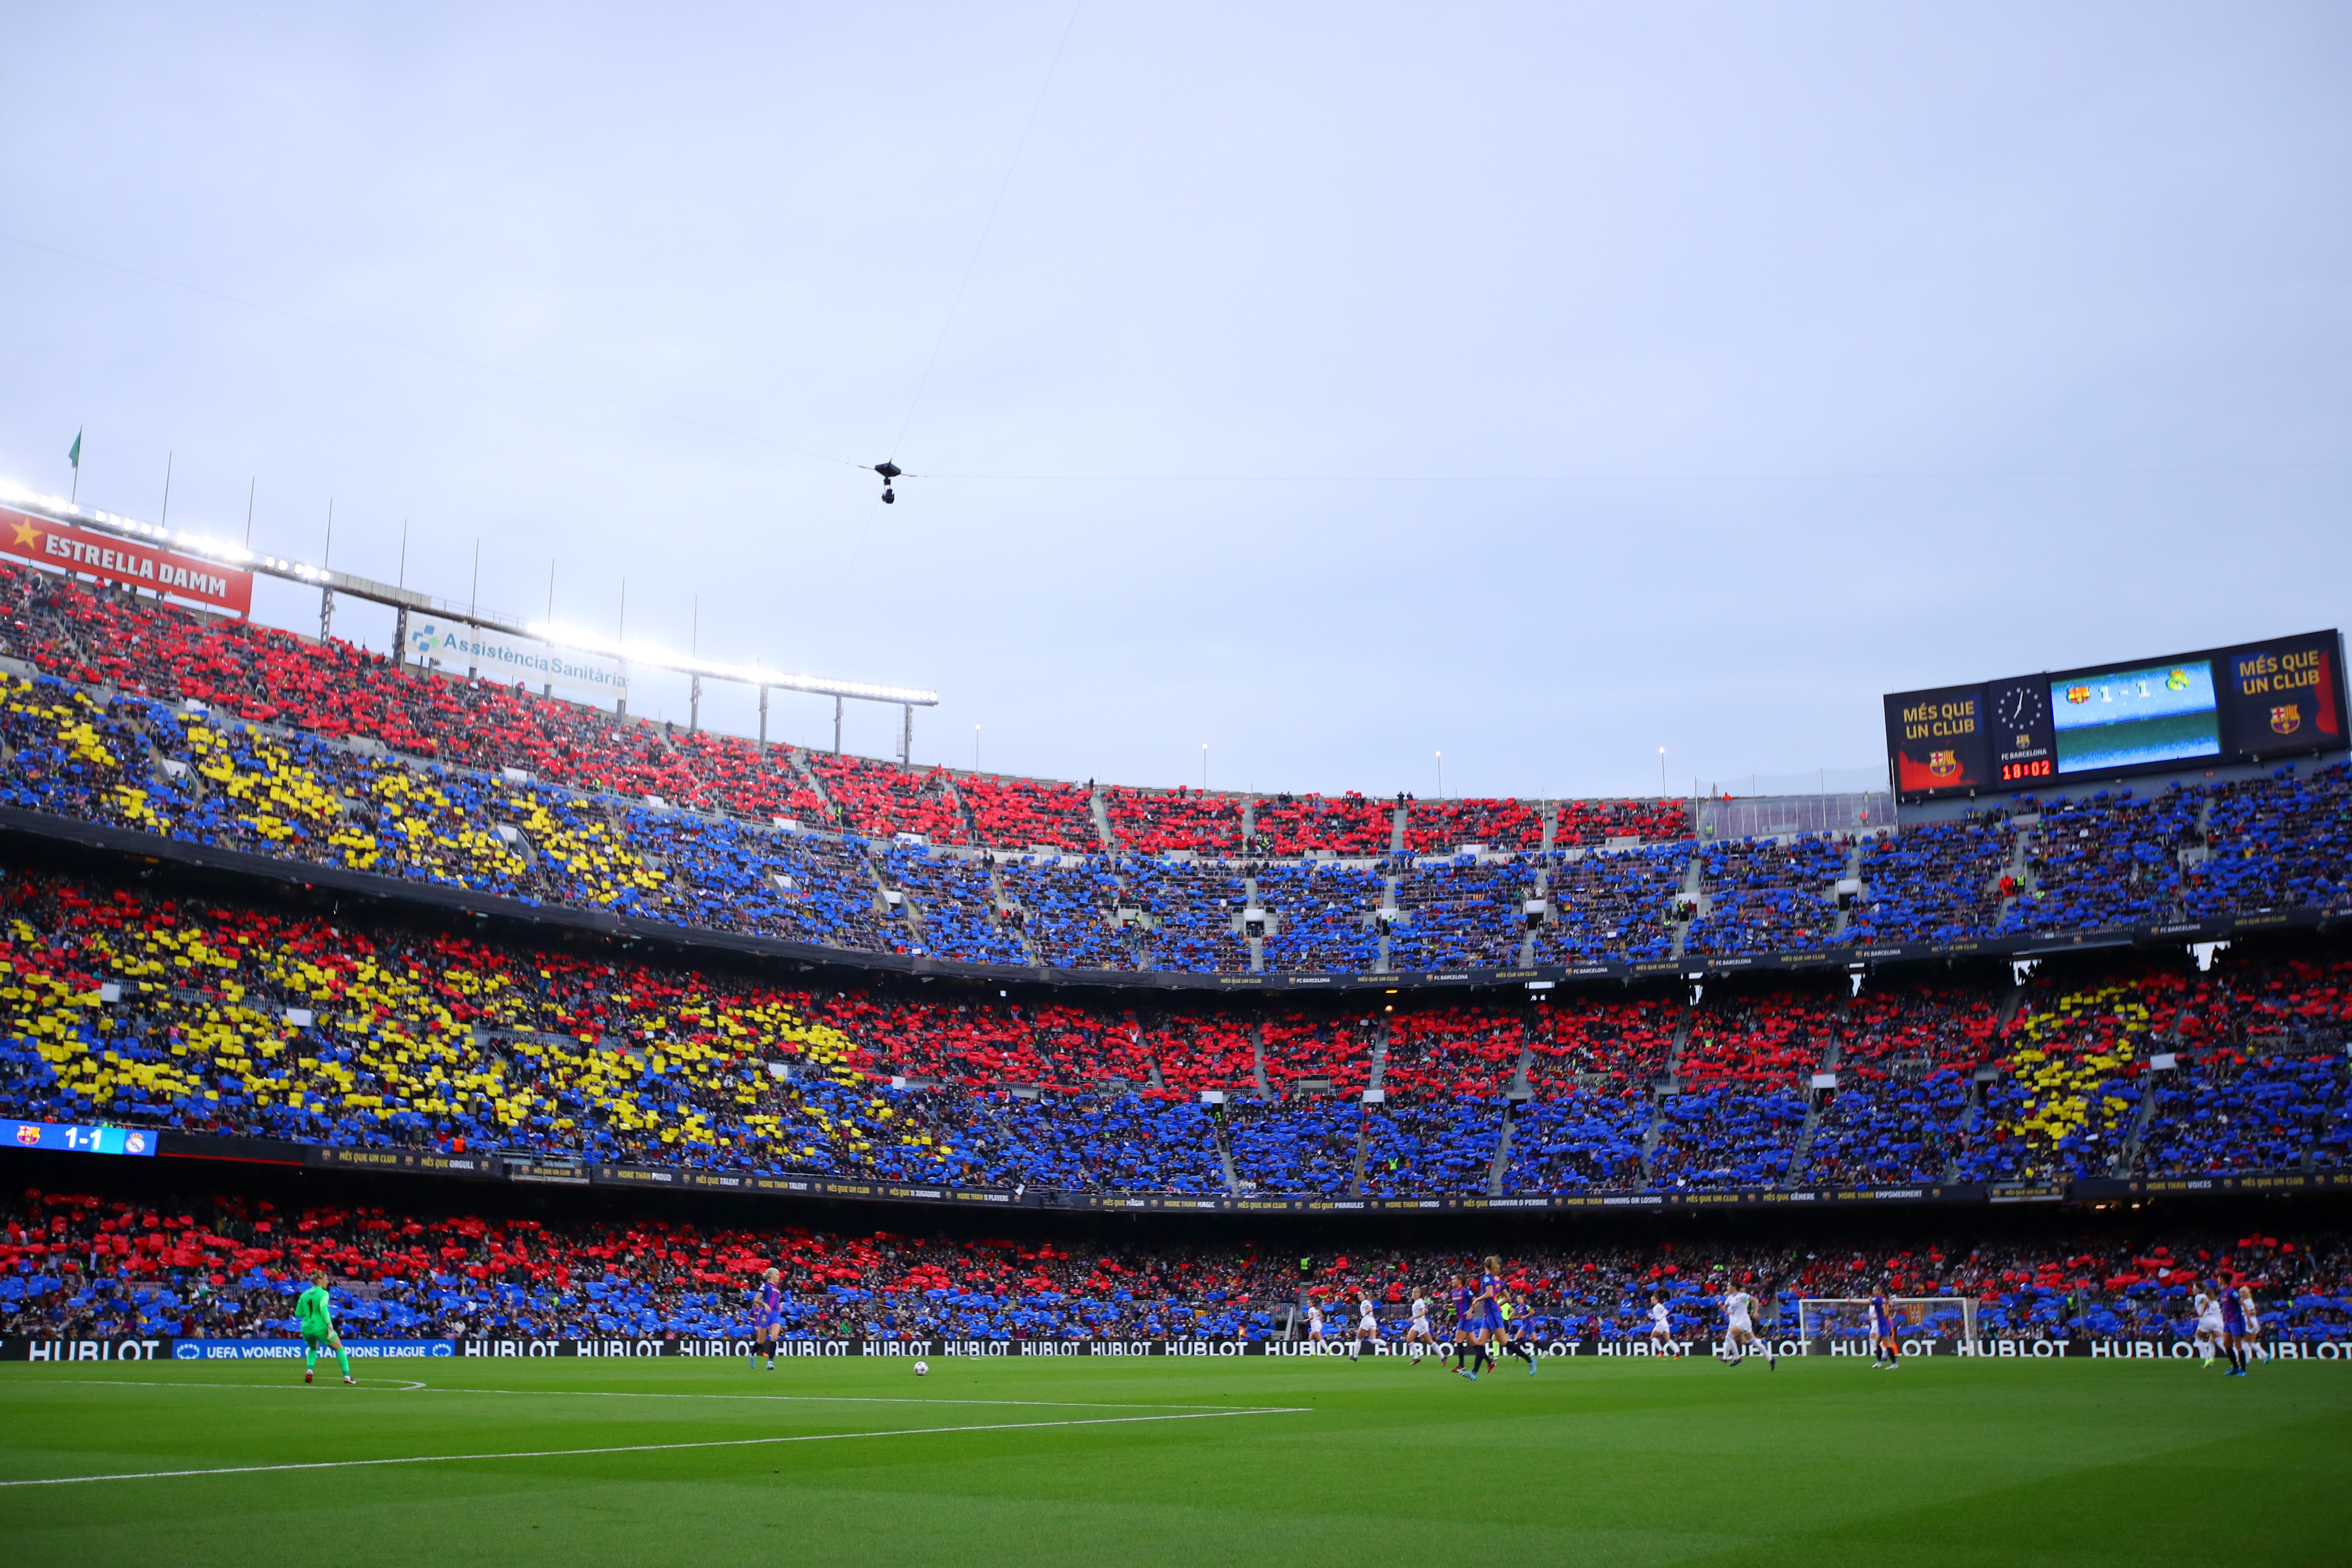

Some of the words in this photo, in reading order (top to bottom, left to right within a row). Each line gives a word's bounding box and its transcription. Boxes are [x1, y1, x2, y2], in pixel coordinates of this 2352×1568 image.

[45, 533, 153, 580] ESTRELLA
[158, 563, 226, 598] DAMM
[443, 632, 548, 671] Assistència
[551, 658, 627, 687] Sanitària
[2239, 654, 2278, 677] MÉS
[2282, 650, 2319, 673] QUE
[2243, 677, 2269, 695] UN
[2273, 669, 2320, 690] CLUB
[2100, 685, 2112, 703] 1
[2138, 681, 2150, 697] 1
[1903, 702, 1938, 723] MÉS
[1941, 700, 1975, 720] QUE
[1906, 723, 1929, 740] UN
[1933, 718, 1975, 737] CLUB
[2010, 748, 2047, 760] BARCELONA
[65, 1126, 102, 1150] 1-1
[339, 1150, 352, 1161] MÉS
[353, 1153, 367, 1164] QUE
[369, 1154, 379, 1162] UN
[380, 1154, 397, 1164] CLUB
[421, 1156, 434, 1167] MÉS
[435, 1159, 448, 1169] QUE
[449, 1160, 474, 1169] ORGULL
[618, 1170, 634, 1179] MORE
[635, 1171, 651, 1180] THAN
[652, 1172, 671, 1181] PROUD
[696, 1175, 706, 1183] MÉS
[708, 1177, 719, 1186] QUE
[827, 1183, 837, 1192] MÉS
[2187, 1180, 2212, 1189] VOICES
[1686, 1194, 1698, 1203] MÉS
[1699, 1195, 1712, 1204] QUE
[1875, 1189, 1922, 1199] EMPOWERMENT
[1463, 1198, 1475, 1207] MÉS
[1476, 1200, 1488, 1208] QUE
[307, 1299, 313, 1318] 1
[207, 1346, 238, 1358] UEFA
[241, 1346, 300, 1358] WOMEN'S
[383, 1346, 425, 1357] LEAGUE
[863, 1341, 932, 1357] HUBLOT
[944, 1341, 1010, 1356] HUBLOT
[1022, 1341, 1080, 1356] HUBLOT
[1091, 1341, 1153, 1356] HUBLOT
[1165, 1341, 1248, 1356] HUBLOT
[1957, 1340, 2069, 1357] HUBLOT
